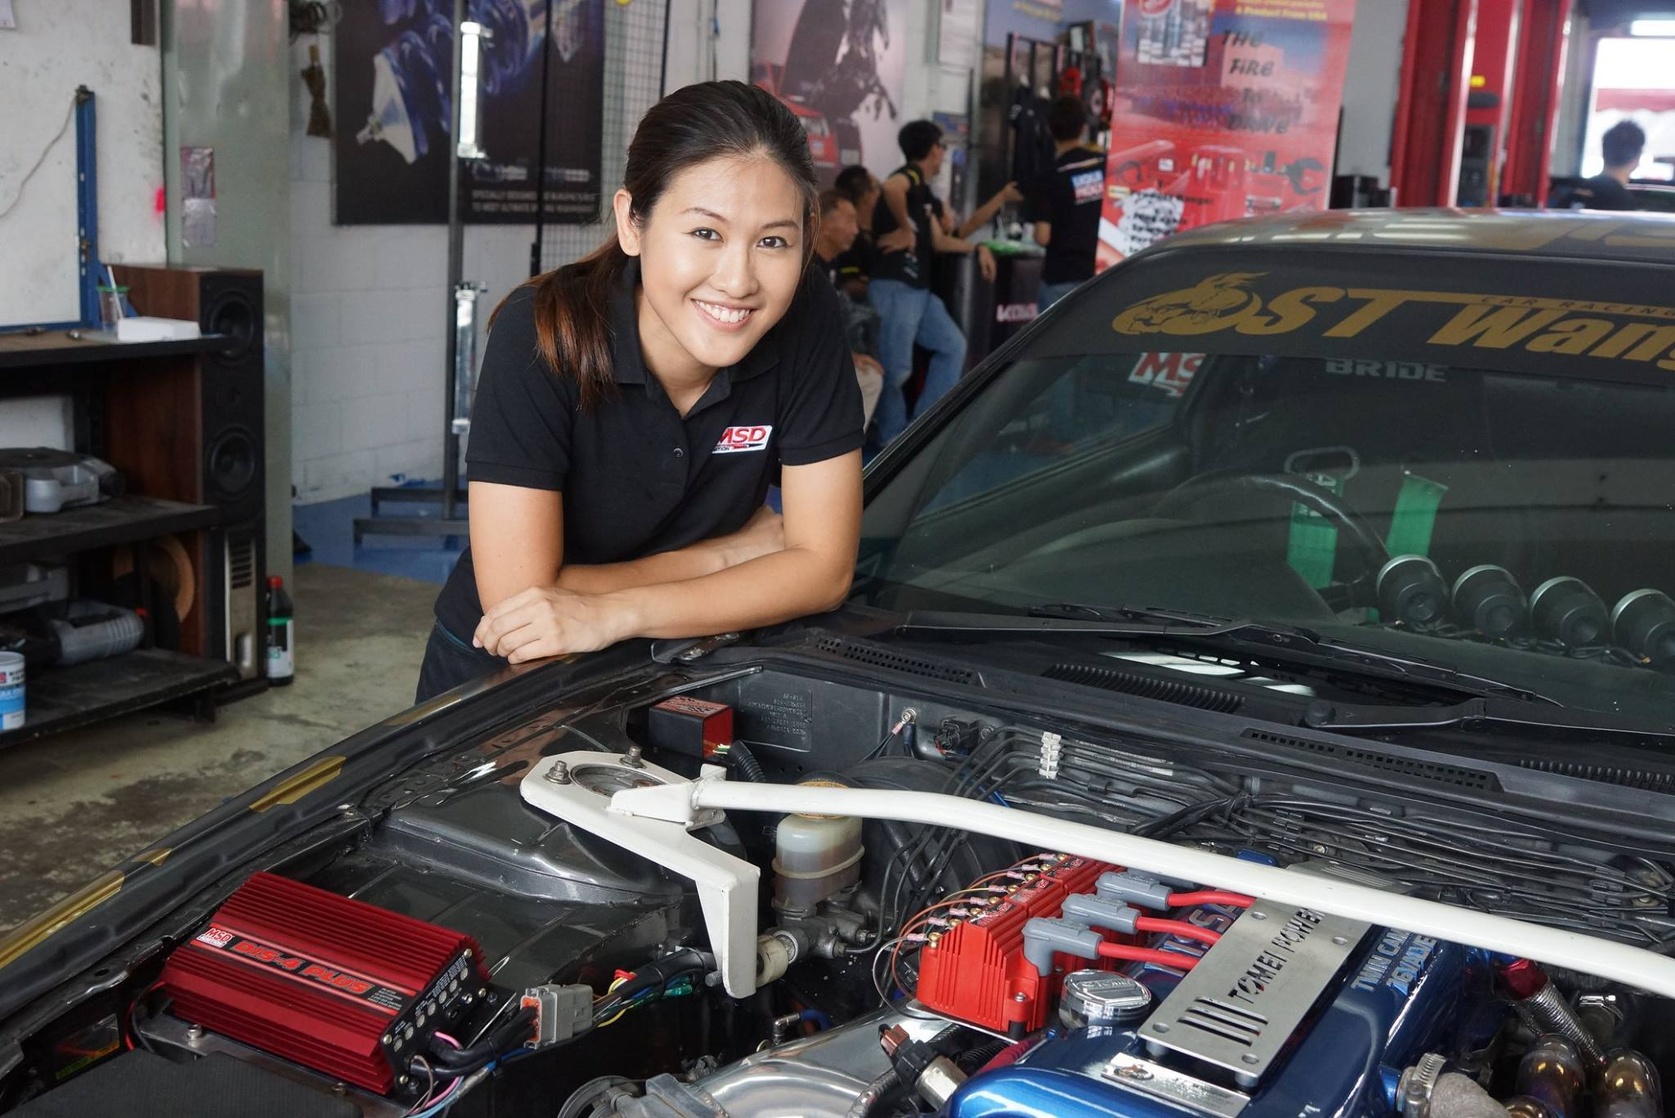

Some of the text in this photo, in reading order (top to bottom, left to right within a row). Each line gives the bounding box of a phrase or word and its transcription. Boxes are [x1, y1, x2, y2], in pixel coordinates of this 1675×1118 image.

[1325, 359, 1448, 382] BRIDE
[205, 927, 233, 942] MSD
[230, 940, 375, 995] DIS-4 PLUS
[1227, 950, 1288, 1004] TOMEI
[1350, 954, 1393, 992] TWIN
